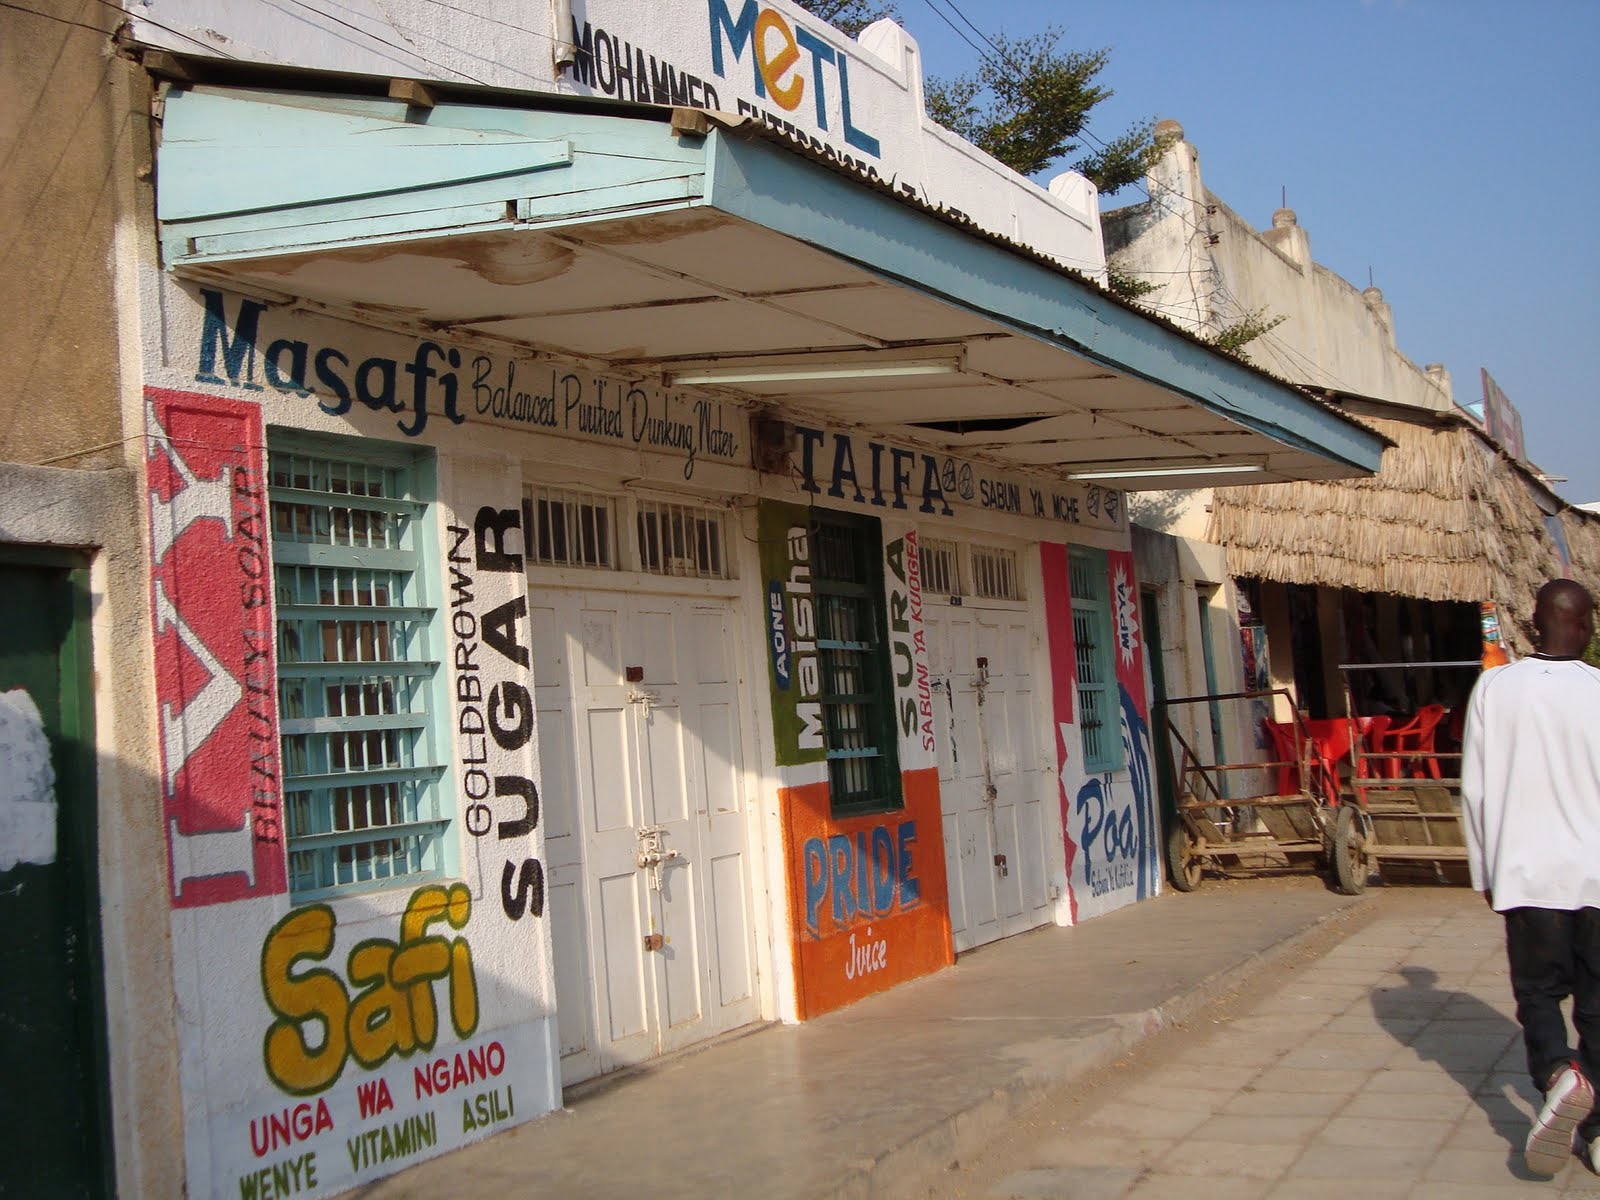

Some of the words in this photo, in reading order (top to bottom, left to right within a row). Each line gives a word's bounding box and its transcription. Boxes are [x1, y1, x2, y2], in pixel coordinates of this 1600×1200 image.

[572, 14, 721, 111] MOHAMMED
[195, 289, 464, 436] Masafi
[472, 356, 557, 427] Balanced
[626, 388, 697, 480] Drinking
[693, 400, 738, 458] Water
[795, 426, 953, 516] TAIFA
[980, 479, 1021, 513] SABUNI
[1029, 488, 1045, 517] YA
[1052, 494, 1079, 523] MCHE
[904, 530, 923, 623] KUOGEA
[1114, 582, 1130, 649] MPYA
[447, 525, 491, 837] GOLDBROWN
[770, 592, 789, 679] AONE
[786, 526, 824, 749] Maisha
[887, 537, 918, 737] SURA
[913, 629, 926, 654] YA
[475, 505, 543, 921] SUGAR
[914, 662, 935, 752] SABUNI
[803, 820, 921, 940] PRIDE
[1077, 778, 1138, 886] Poa
[260, 882, 479, 1096] Safi
[846, 927, 887, 979] Juice
[240, 1152, 318, 1200] WENYE
[347, 1112, 438, 1173] VITAMINI
[462, 1085, 514, 1133] ASILI
[250, 1099, 333, 1157] UNGA
[357, 1077, 394, 1120] WA
[415, 1041, 505, 1100] NGANO
